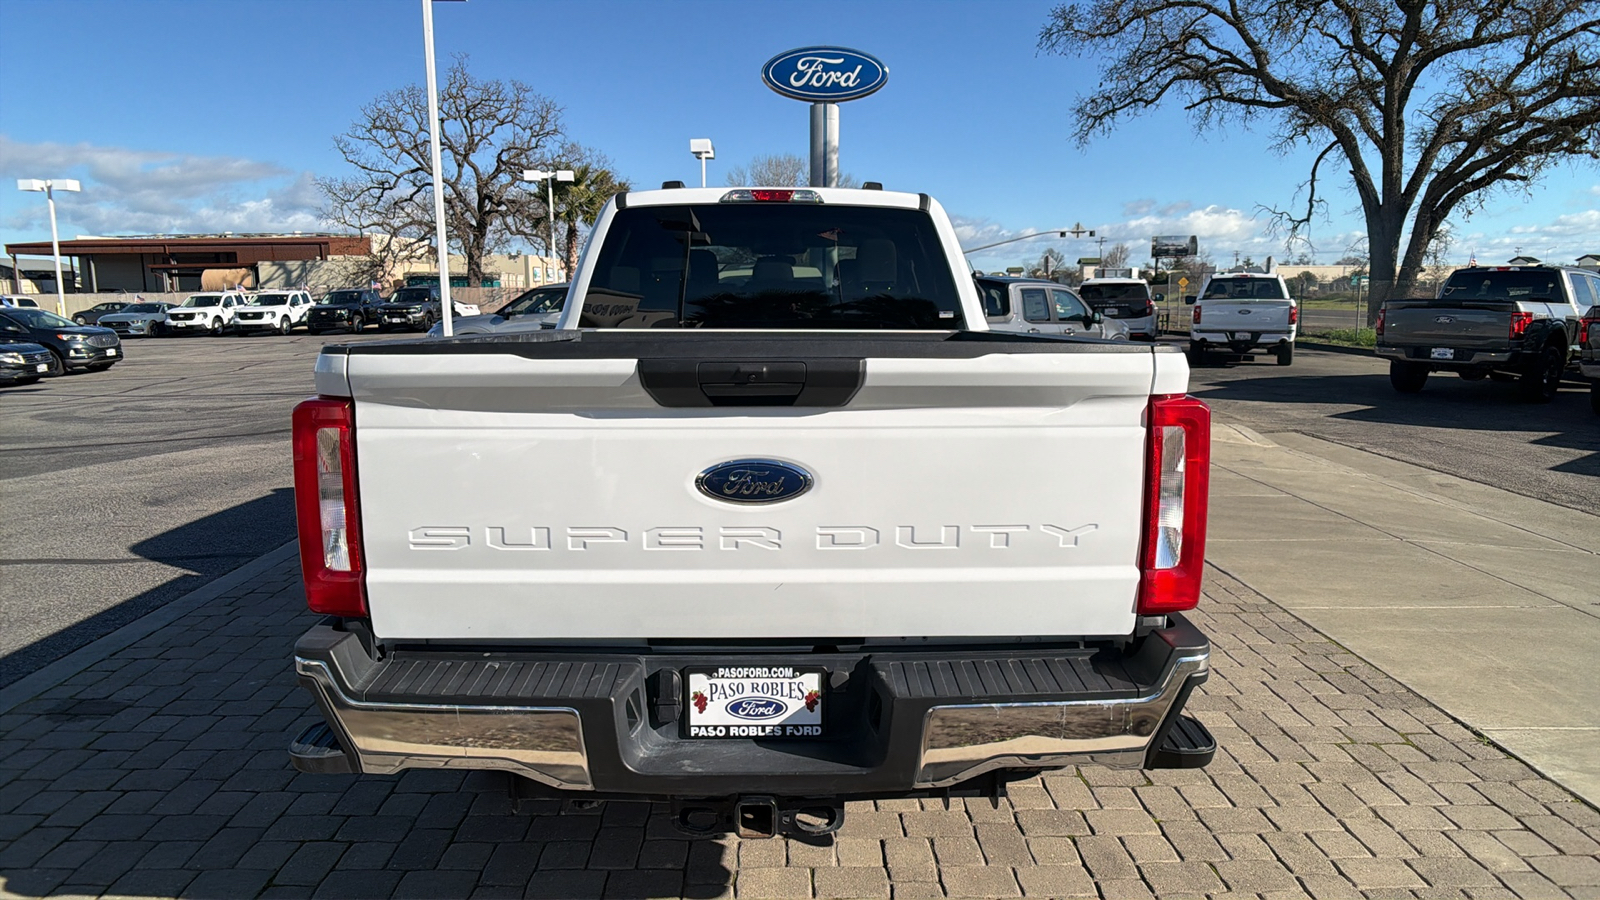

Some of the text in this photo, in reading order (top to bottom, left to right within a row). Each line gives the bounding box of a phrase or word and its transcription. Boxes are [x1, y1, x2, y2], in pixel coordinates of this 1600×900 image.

[789, 56, 862, 88] Ford
[722, 469, 785, 495] Ford
[408, 523, 1099, 551] SUPER DUTY
[718, 667, 794, 678] PASOFORD.COM
[709, 681, 805, 702] PASO ROBLES
[738, 701, 776, 715] Ford
[690, 726, 822, 737] PASO ROBLES FORD
